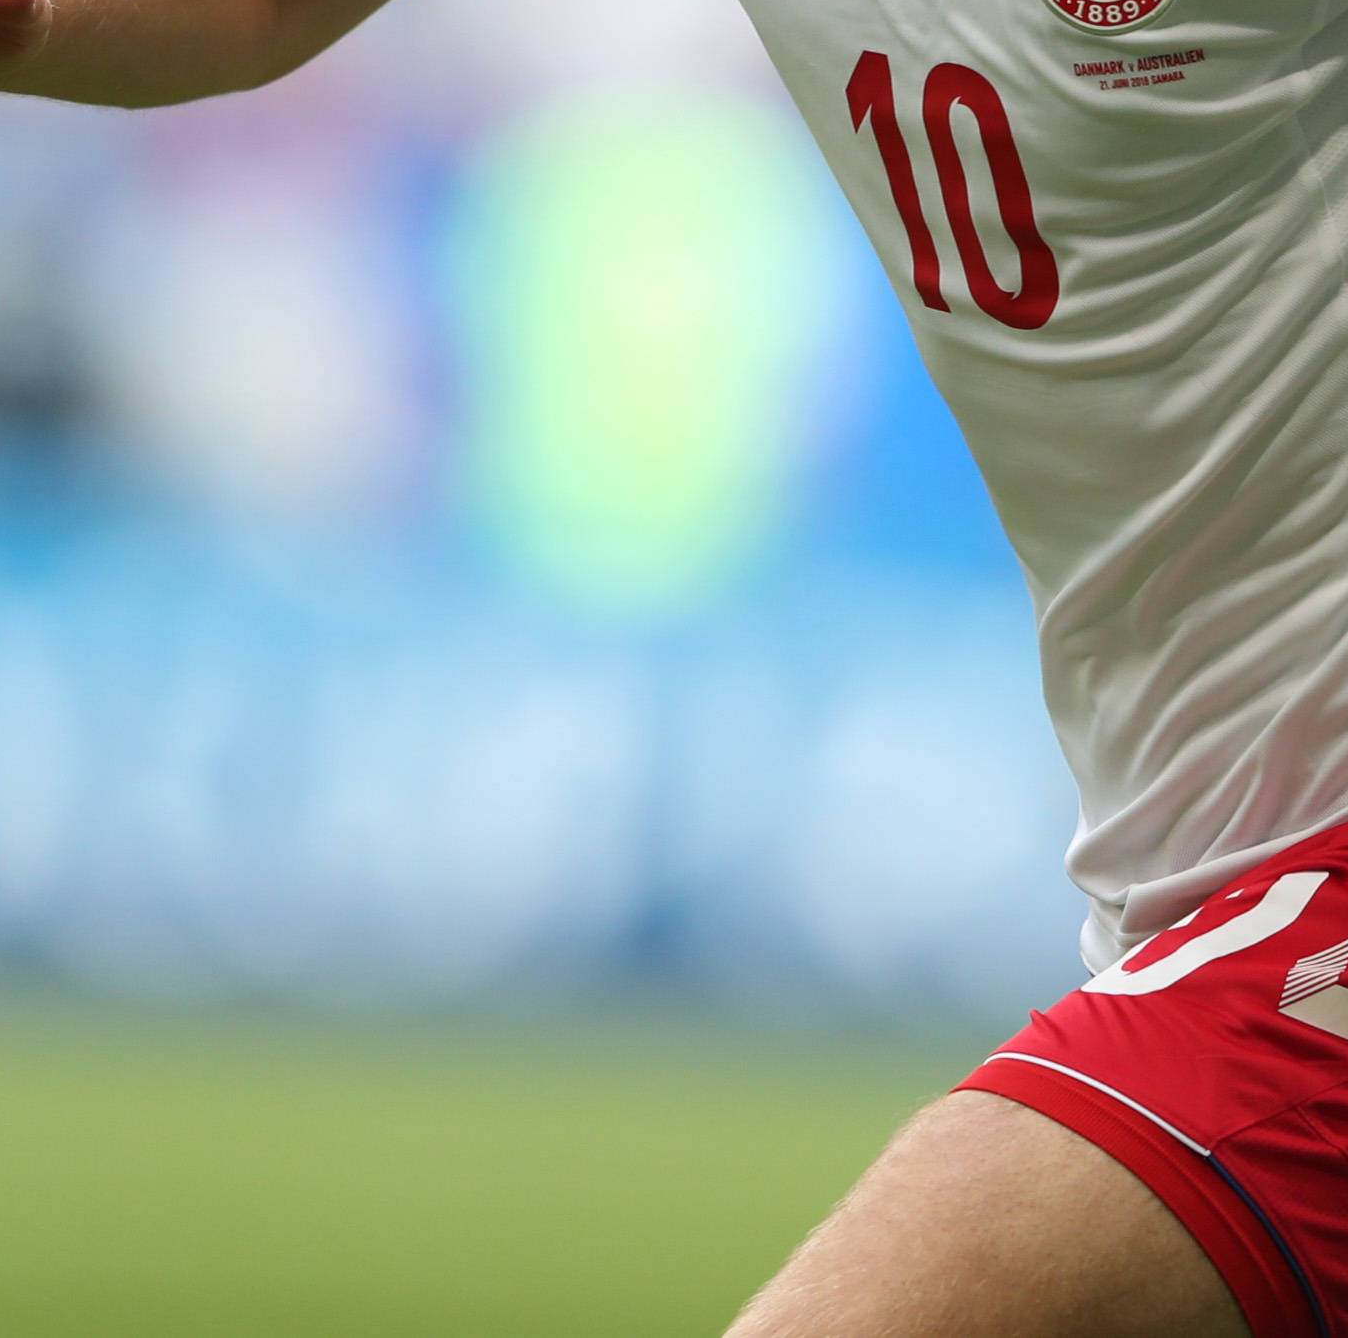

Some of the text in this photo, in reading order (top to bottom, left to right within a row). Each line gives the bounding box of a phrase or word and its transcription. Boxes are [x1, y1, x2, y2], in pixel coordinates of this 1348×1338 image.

[1073, 0, 1140, 23] 1889
[1073, 60, 1126, 77] DANMARK
[1137, 48, 1206, 72] AUSTRALIEN
[846, 50, 1060, 330] 10
